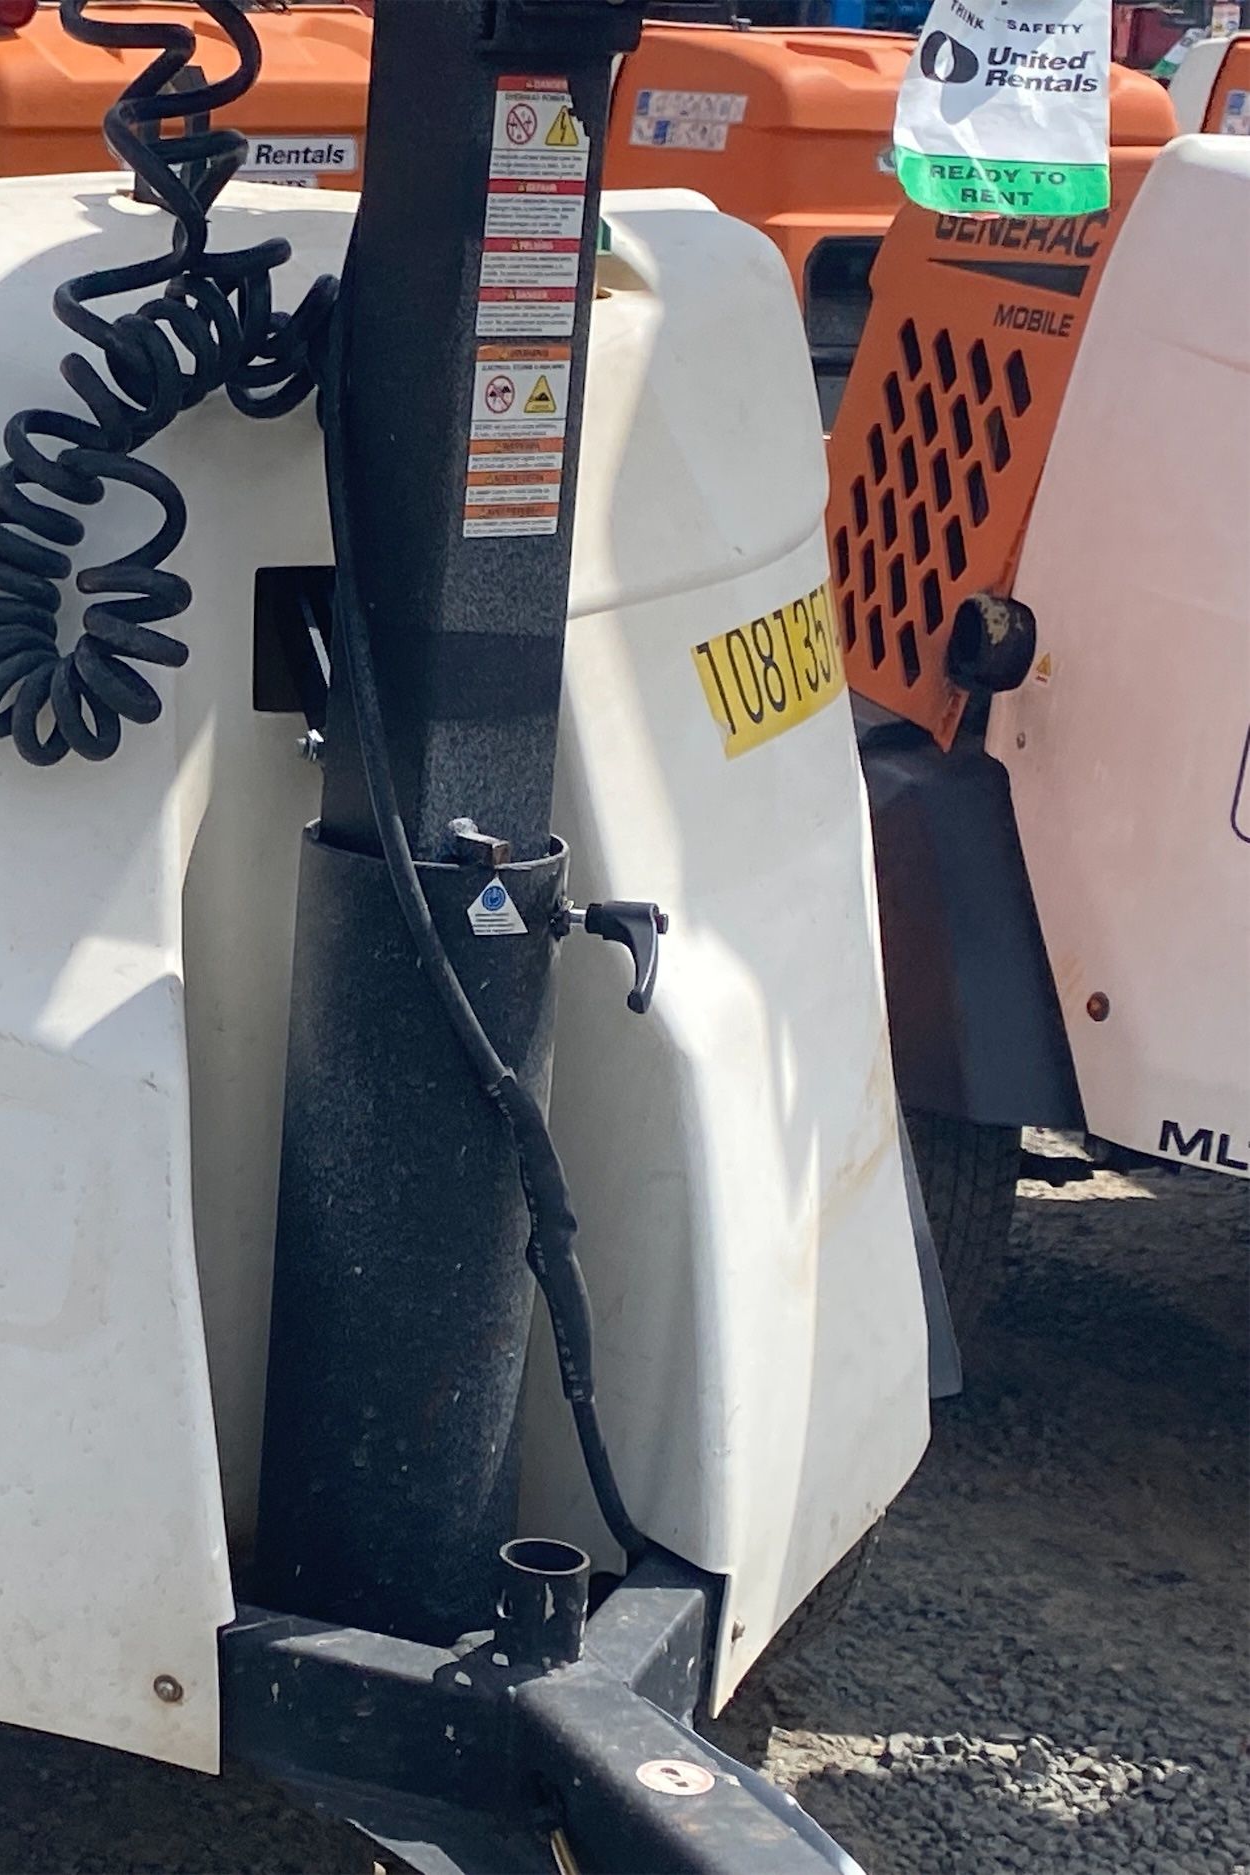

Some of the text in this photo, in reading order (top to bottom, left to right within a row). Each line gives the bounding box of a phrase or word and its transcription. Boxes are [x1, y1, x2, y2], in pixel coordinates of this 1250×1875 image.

[950, 0, 1084, 35] THINK SAFETY
[987, 46, 1090, 70] United
[984, 69, 1099, 93] Rentals
[255, 143, 345, 165] Rentals
[929, 164, 1067, 185] READY TO
[960, 188, 1035, 206] RENT
[934, 209, 1111, 259] GENERAC
[993, 303, 1075, 338] MOBILE
[1158, 1119, 1250, 1171] ML
